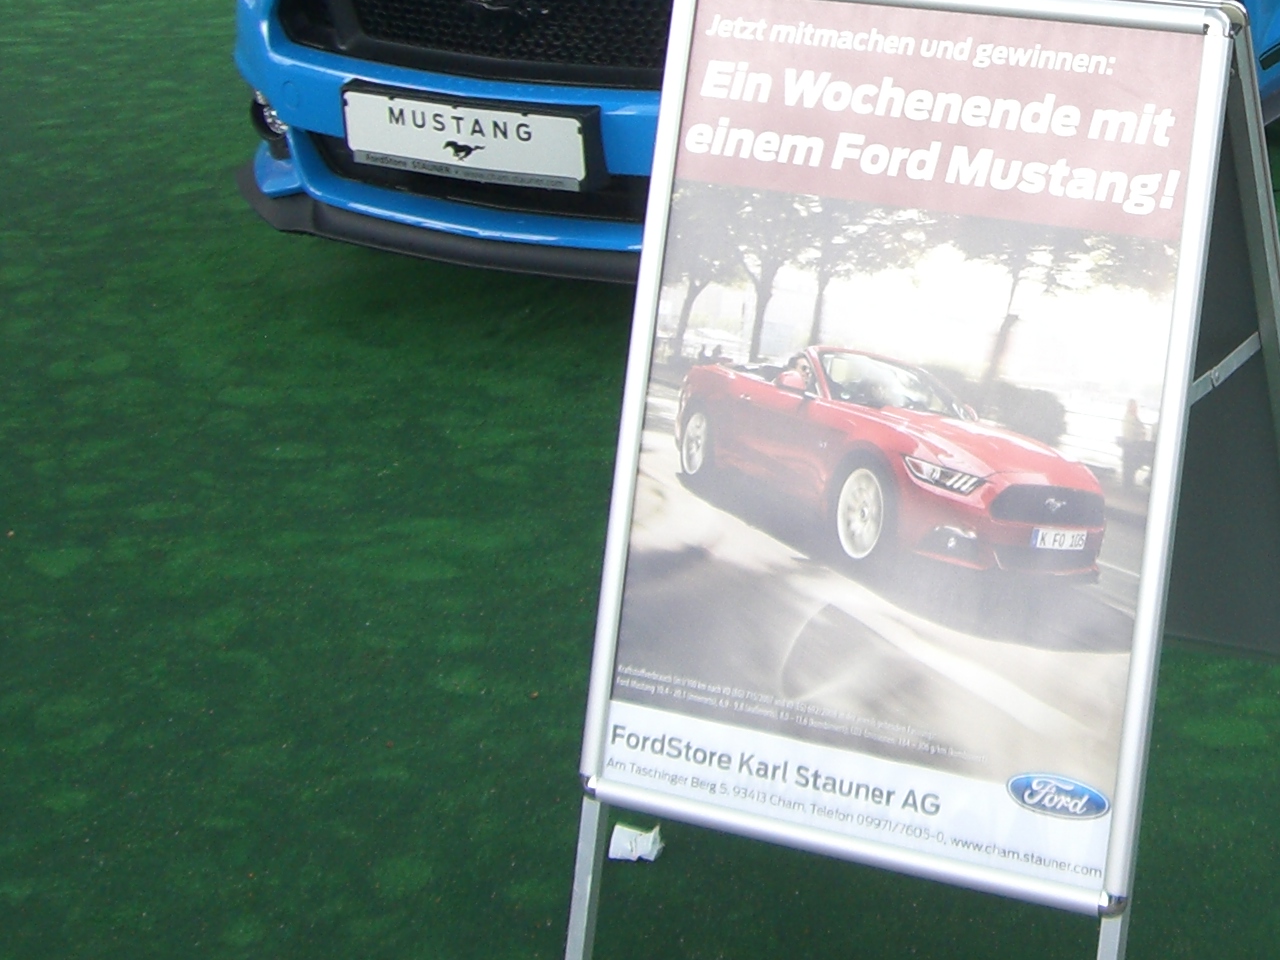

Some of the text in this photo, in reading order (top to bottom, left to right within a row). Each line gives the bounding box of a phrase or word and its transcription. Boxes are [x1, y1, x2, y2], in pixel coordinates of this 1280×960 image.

[705, 13, 1117, 76] Jetzt mitmachen und gewinnen:
[387, 106, 533, 143] MUSTANG
[700, 59, 1177, 148] Ein Wochenende mit
[684, 116, 1182, 216] einem Ford Mustang!
[610, 723, 941, 817] FordStore Karl Stauner AG
[1018, 776, 1094, 818] Ford
[606, 757, 626, 772] Am
[628, 761, 689, 787] Taschinger
[690, 776, 717, 795] Berg
[809, 802, 855, 823] Telefon
[950, 836, 1103, 879] www.cham.stauner.com
